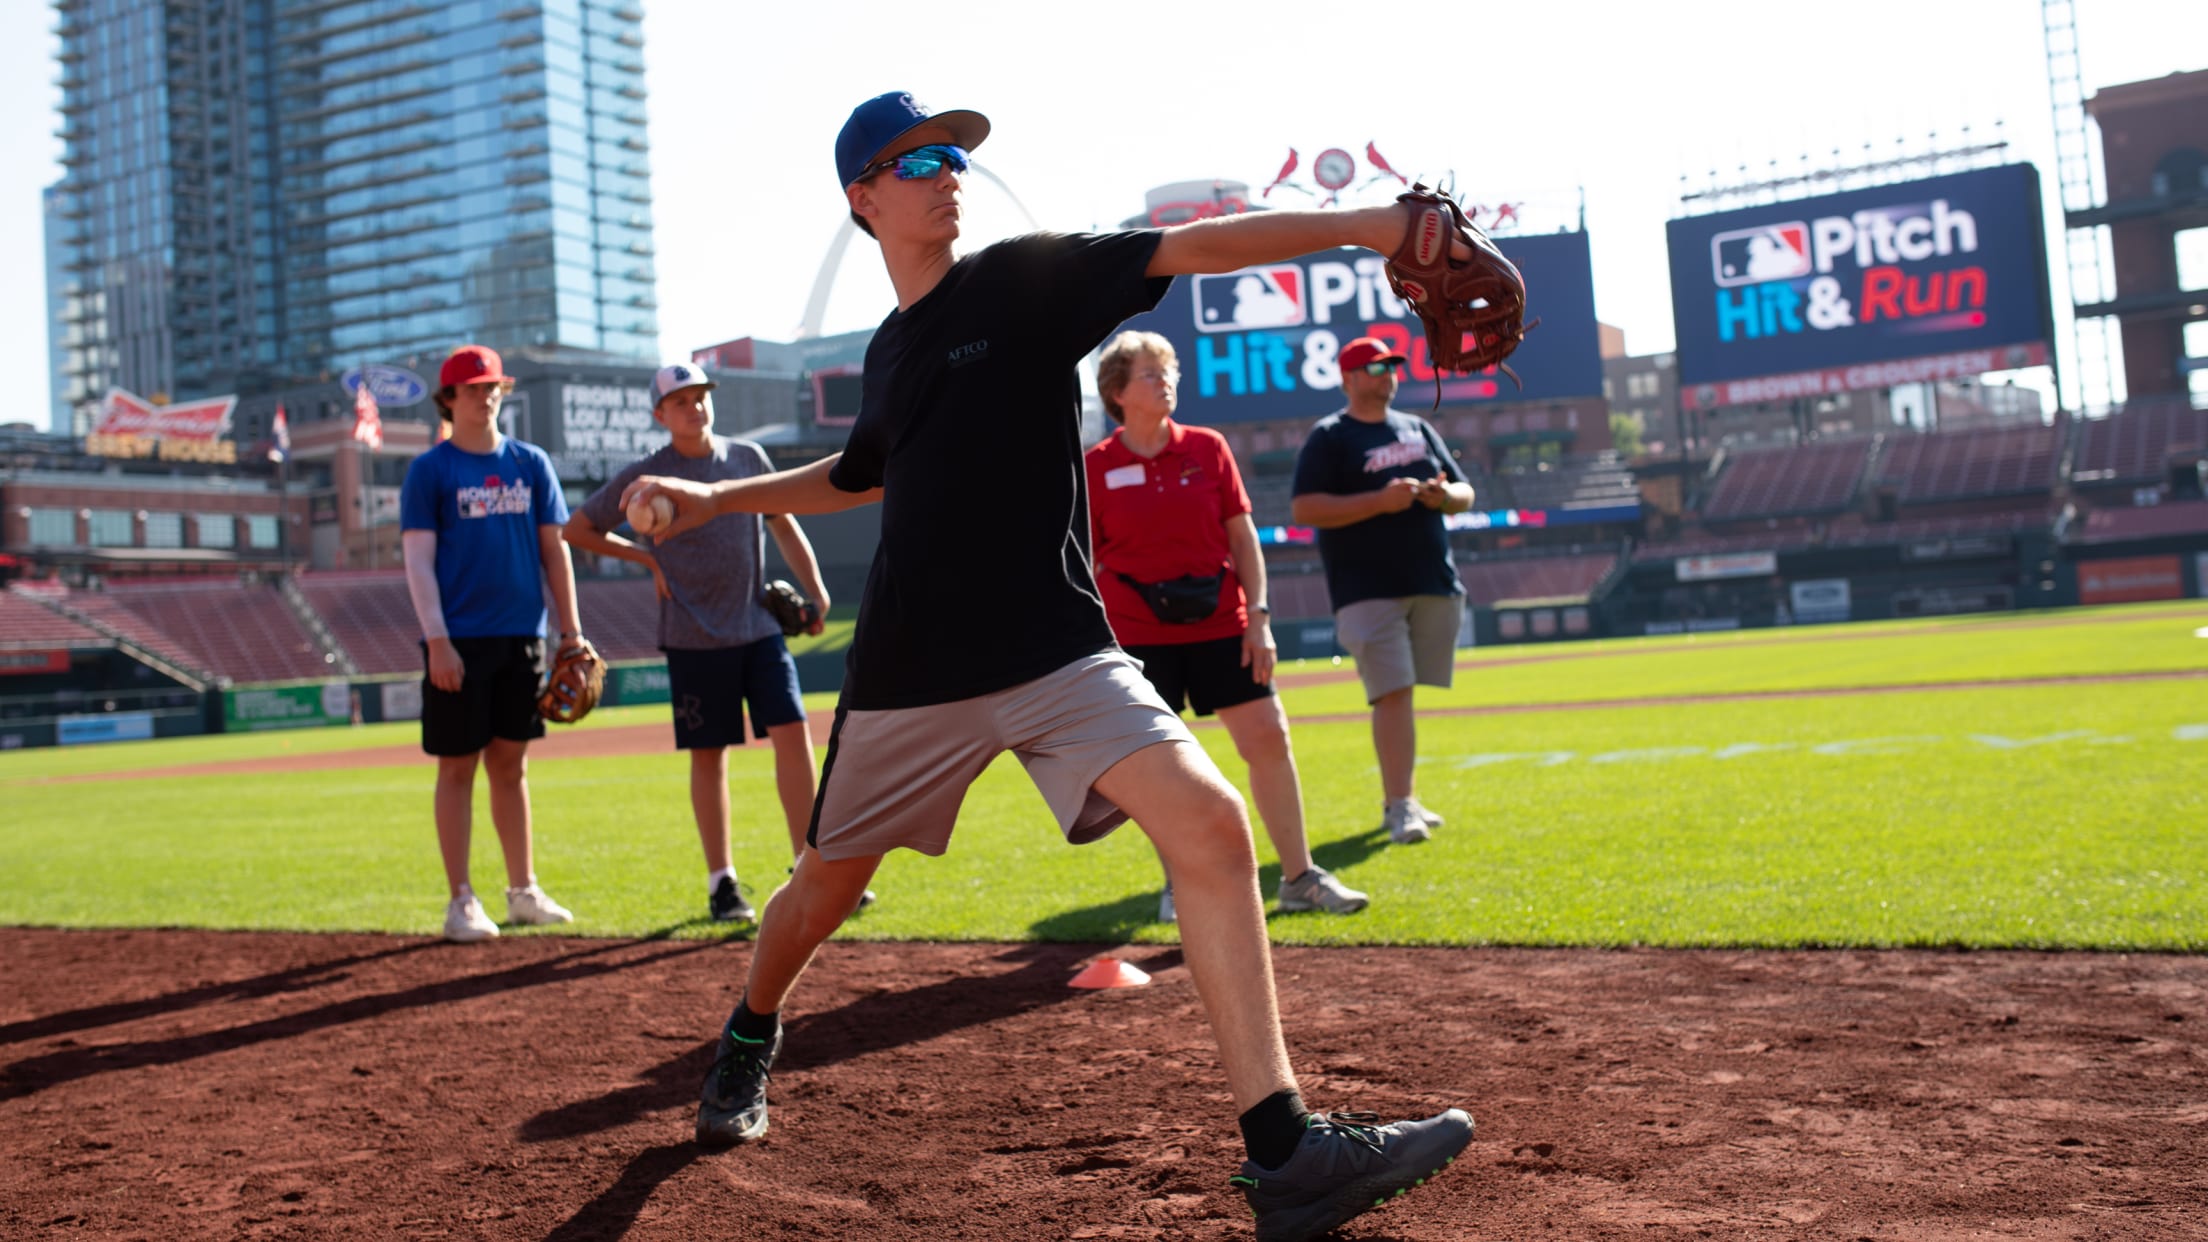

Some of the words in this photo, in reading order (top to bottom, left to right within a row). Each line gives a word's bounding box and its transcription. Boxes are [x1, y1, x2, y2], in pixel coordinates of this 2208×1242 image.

[1421, 212, 1438, 259] Wilson
[1812, 199, 1978, 274] Pitch
[1308, 257, 1422, 325] Pit
[1715, 281, 1804, 342] Hit
[1806, 275, 1855, 330] &
[1859, 266, 1988, 323] Run
[947, 340, 988, 361] AFTCO
[1196, 331, 1296, 397] Hit
[1301, 330, 1343, 390] &
[562, 384, 624, 408] FROM
[626, 387, 652, 408] TH
[1727, 376, 1823, 403] BROWN
[1846, 351, 1993, 389] CROUPPEN
[563, 406, 605, 428] LOU
[608, 409, 652, 430] AND
[563, 428, 631, 451] WE'RE
[633, 430, 673, 454] PRO
